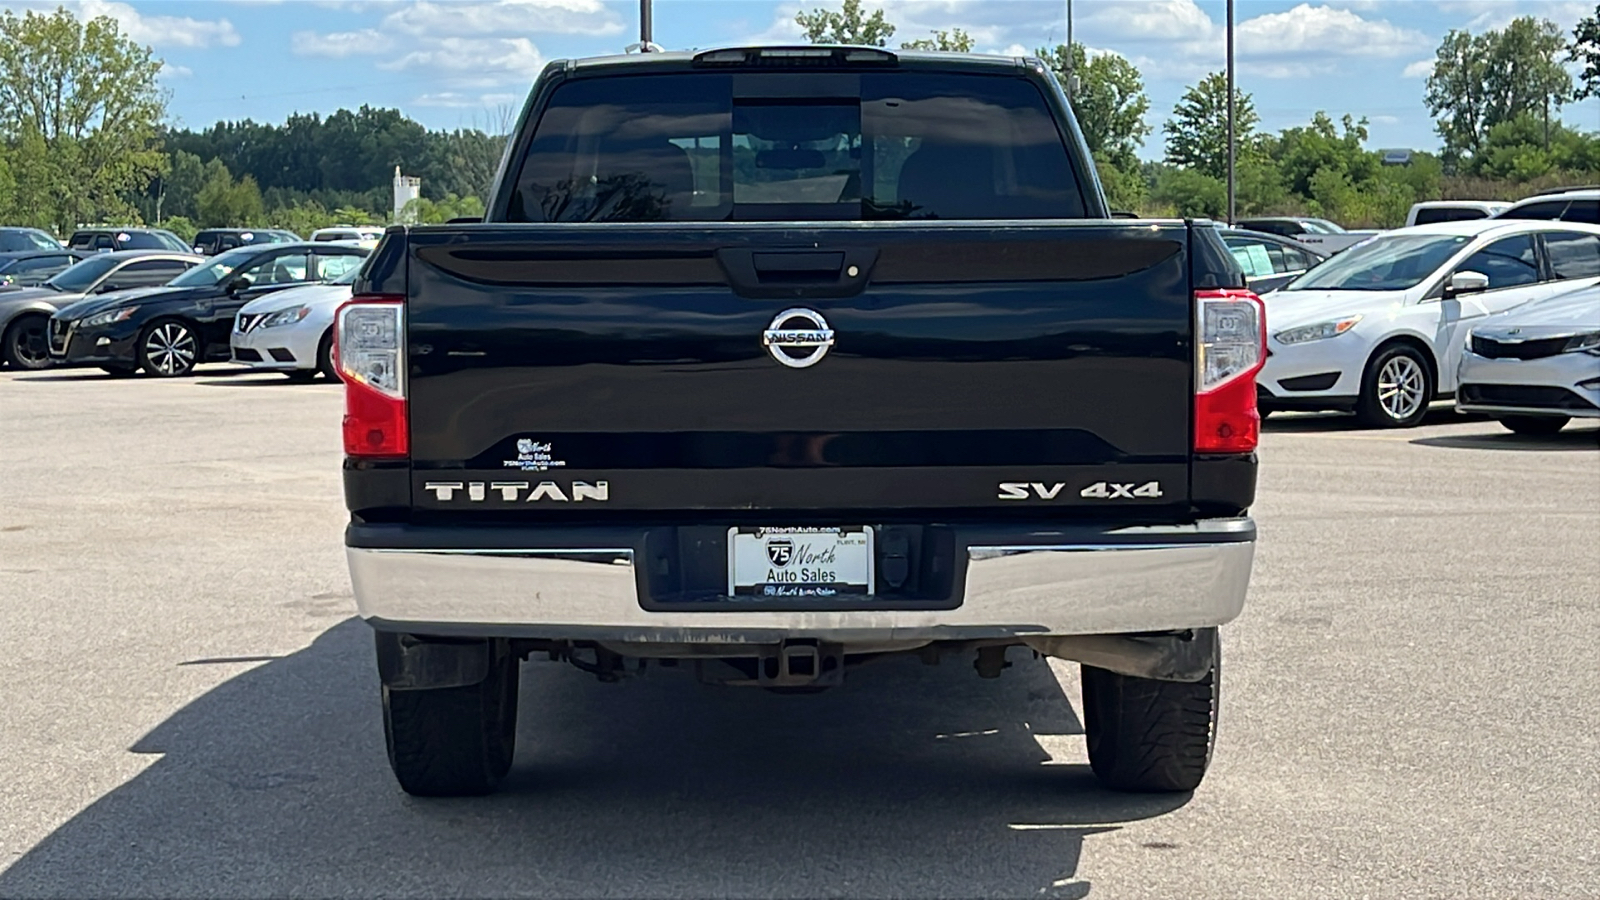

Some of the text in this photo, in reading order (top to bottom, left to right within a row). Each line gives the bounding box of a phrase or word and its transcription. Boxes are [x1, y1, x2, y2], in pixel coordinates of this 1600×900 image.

[770, 333, 826, 343] NISSAN
[425, 481, 608, 501] TITAN
[998, 482, 1066, 499] SV
[759, 526, 841, 534] 75NorthAuto.com
[771, 543, 836, 565] 75 North
[766, 568, 836, 582] Auto Sales
